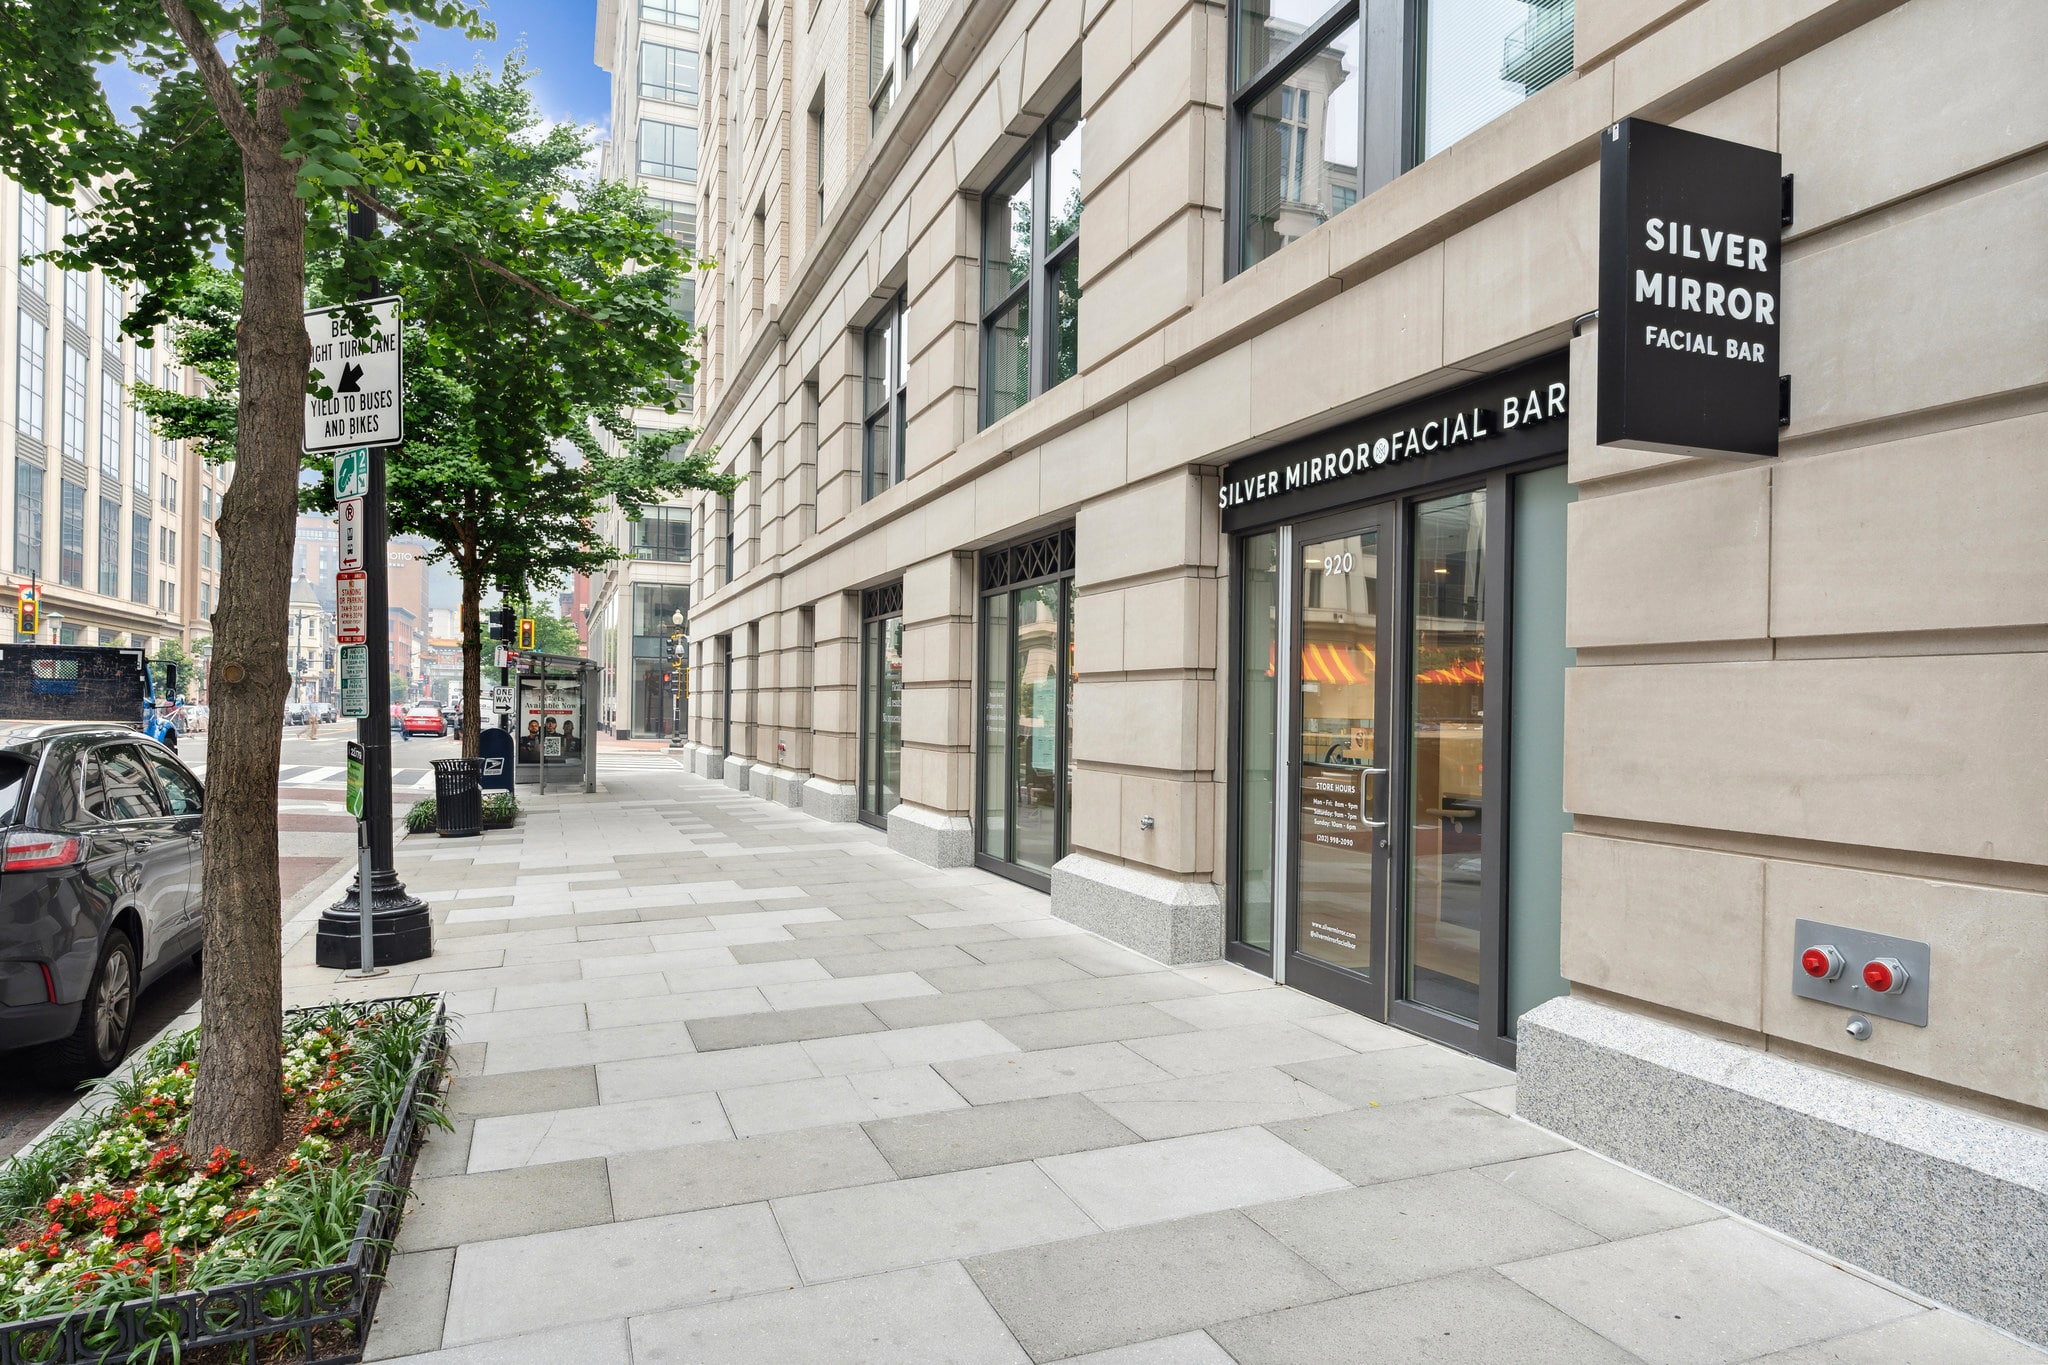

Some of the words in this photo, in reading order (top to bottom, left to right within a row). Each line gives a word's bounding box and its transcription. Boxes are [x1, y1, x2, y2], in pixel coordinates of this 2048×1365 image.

[1645, 217, 1768, 273] SILVER
[1635, 269, 1775, 325] MIRROR
[311, 343, 333, 363] IGHT
[370, 333, 396, 354] LANE
[1645, 325, 1718, 356] FACIAL
[1726, 338, 1765, 363] BAR
[311, 397, 340, 417] YIELD
[344, 395, 356, 413] TO
[360, 390, 393, 411] BUSES
[324, 419, 345, 438] AND
[350, 414, 379, 435] BIKES
[1218, 470, 1278, 509] SILVER
[1285, 442, 1371, 491] MIRROR
[1391, 407, 1488, 461] FACIAL
[1503, 382, 1567, 429] BAR
[359, 450, 366, 468] 2
[1324, 552, 1353, 577] 920
[341, 588, 362, 596] STANDING
[496, 688, 513, 696] ONE
[1316, 782, 1334, 791] STORE
[1335, 784, 1356, 794] HOURS
[1313, 798, 1322, 806] Mon
[1316, 834, 1329, 843] (202)
[1329, 835, 1354, 847] 998-2090
